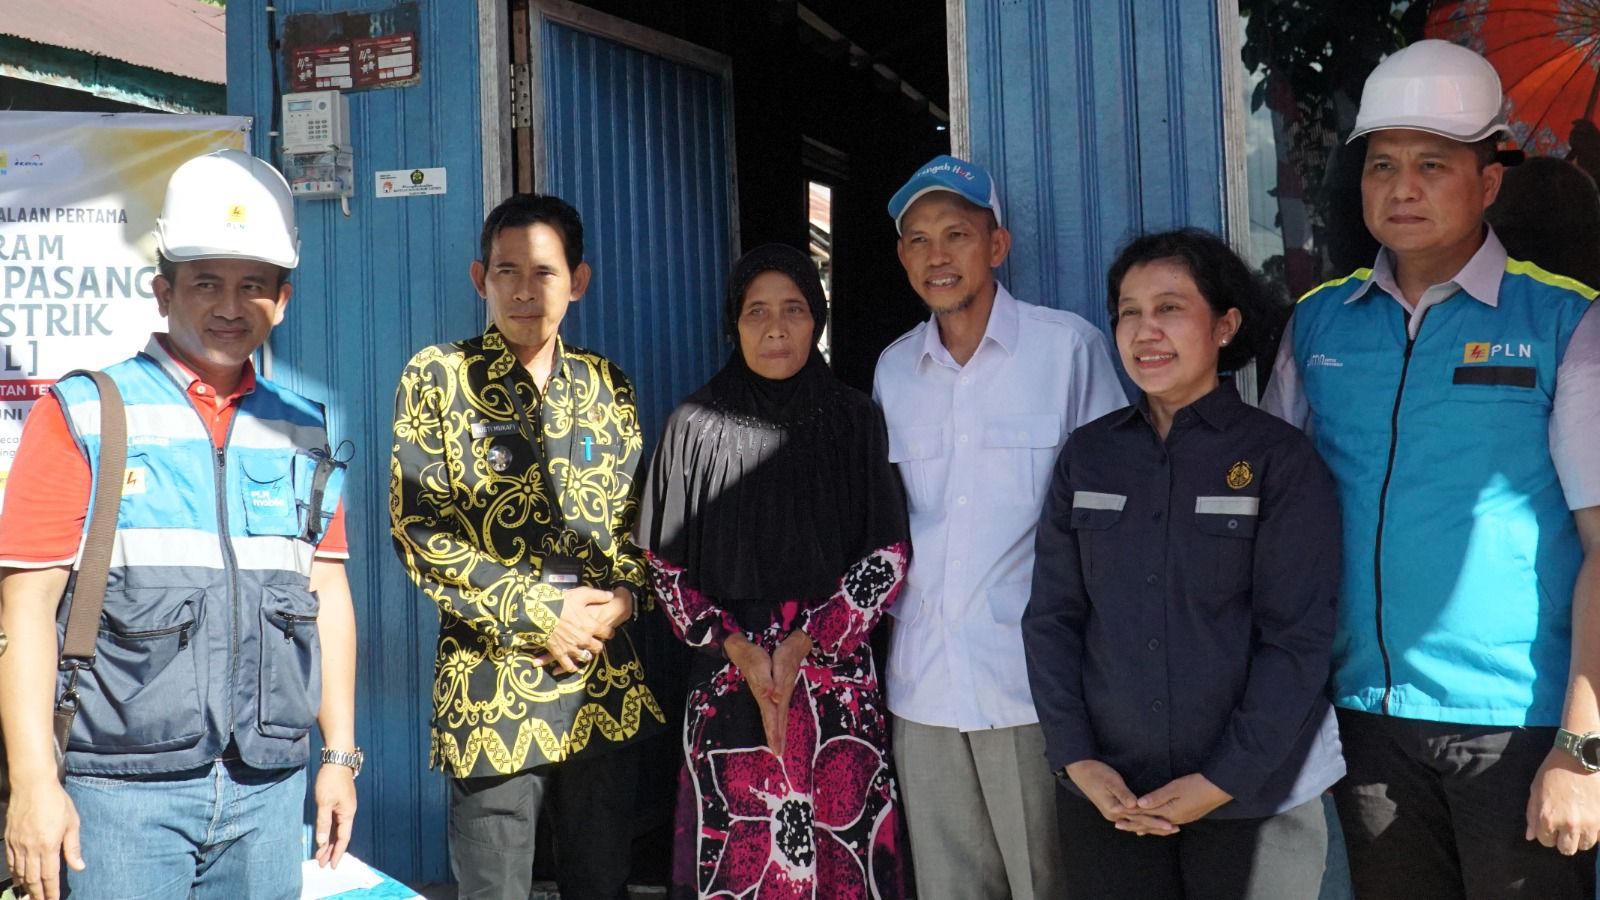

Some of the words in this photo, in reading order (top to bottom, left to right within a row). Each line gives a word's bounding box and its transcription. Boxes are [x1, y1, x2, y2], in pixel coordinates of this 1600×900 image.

[55, 207, 128, 224] PERTAMA
[4, 266, 155, 299] PASANG
[1491, 343, 1531, 358] PLN
[30, 384, 52, 396] TE
